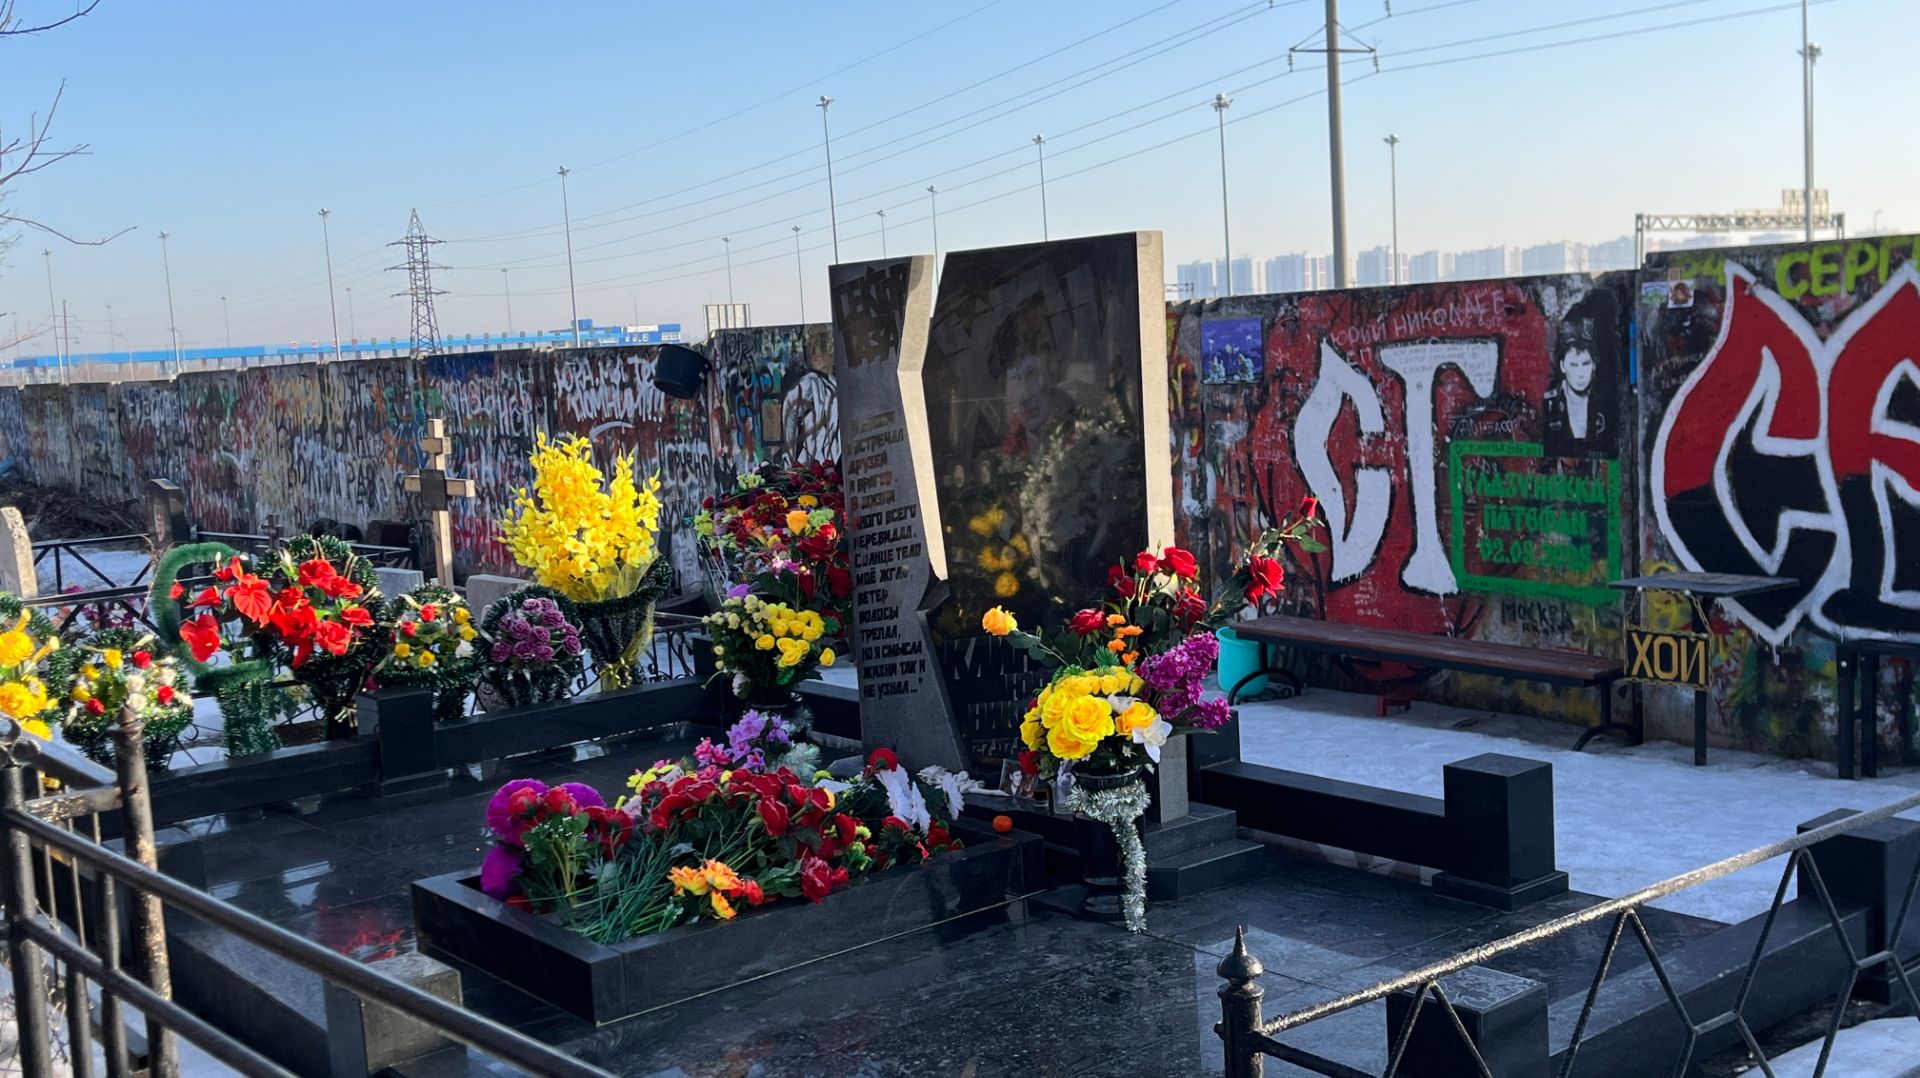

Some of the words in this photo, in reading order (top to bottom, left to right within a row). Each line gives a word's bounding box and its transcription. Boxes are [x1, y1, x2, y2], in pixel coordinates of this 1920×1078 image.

[1775, 237, 1920, 300] СЕРГ
[885, 504, 917, 525] ВСЕГО
[896, 543, 922, 561] ТЕЛО
[856, 567, 876, 587] МОЁ
[857, 589, 888, 606] ВЕТЕР
[859, 605, 899, 625] ВОЛОСЫ
[861, 647, 873, 661] НО
[874, 646, 881, 660] Я
[882, 641, 923, 658] СМЫСЛА
[863, 663, 897, 680] ЖИЗНИ
[899, 660, 917, 675] ТАК
[919, 659, 926, 674] И
[863, 684, 876, 698] НЕ
